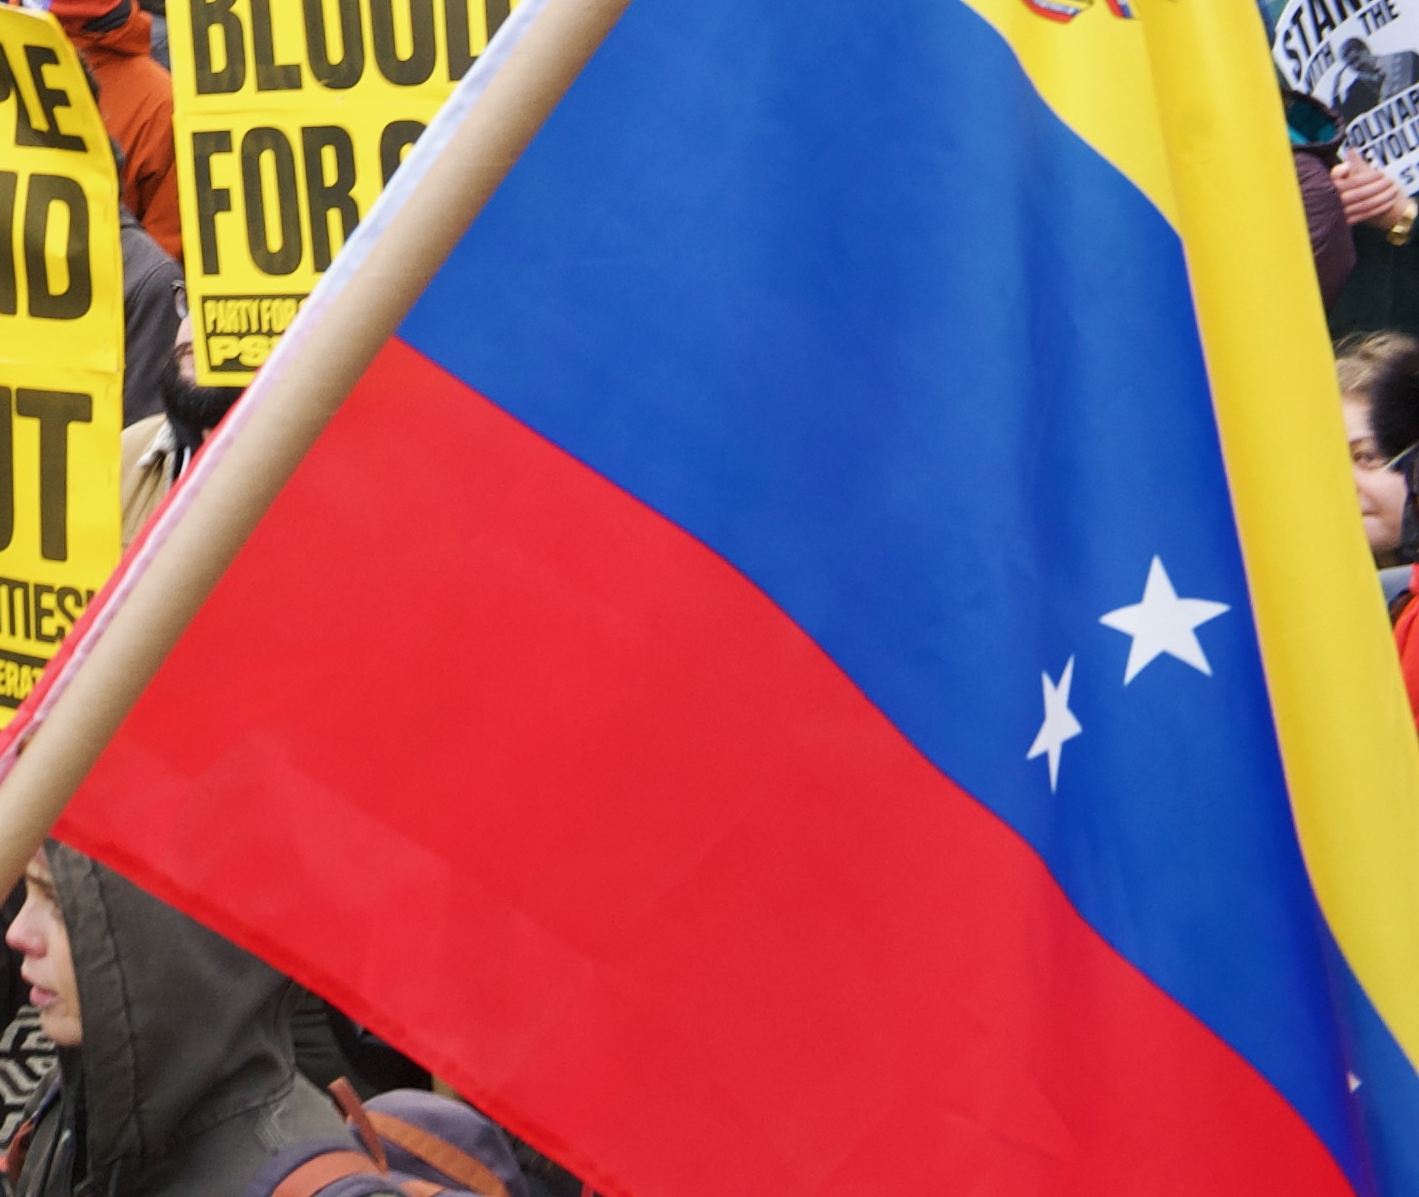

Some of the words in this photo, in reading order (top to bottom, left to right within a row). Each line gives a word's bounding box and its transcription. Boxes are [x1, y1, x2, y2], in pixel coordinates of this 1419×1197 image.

[1350, 91, 1419, 149] OLIVAR
[191, 124, 361, 277] FOR
[205, 298, 260, 334] PARTY
[261, 298, 296, 334] FOR
[209, 334, 280, 368] PS
